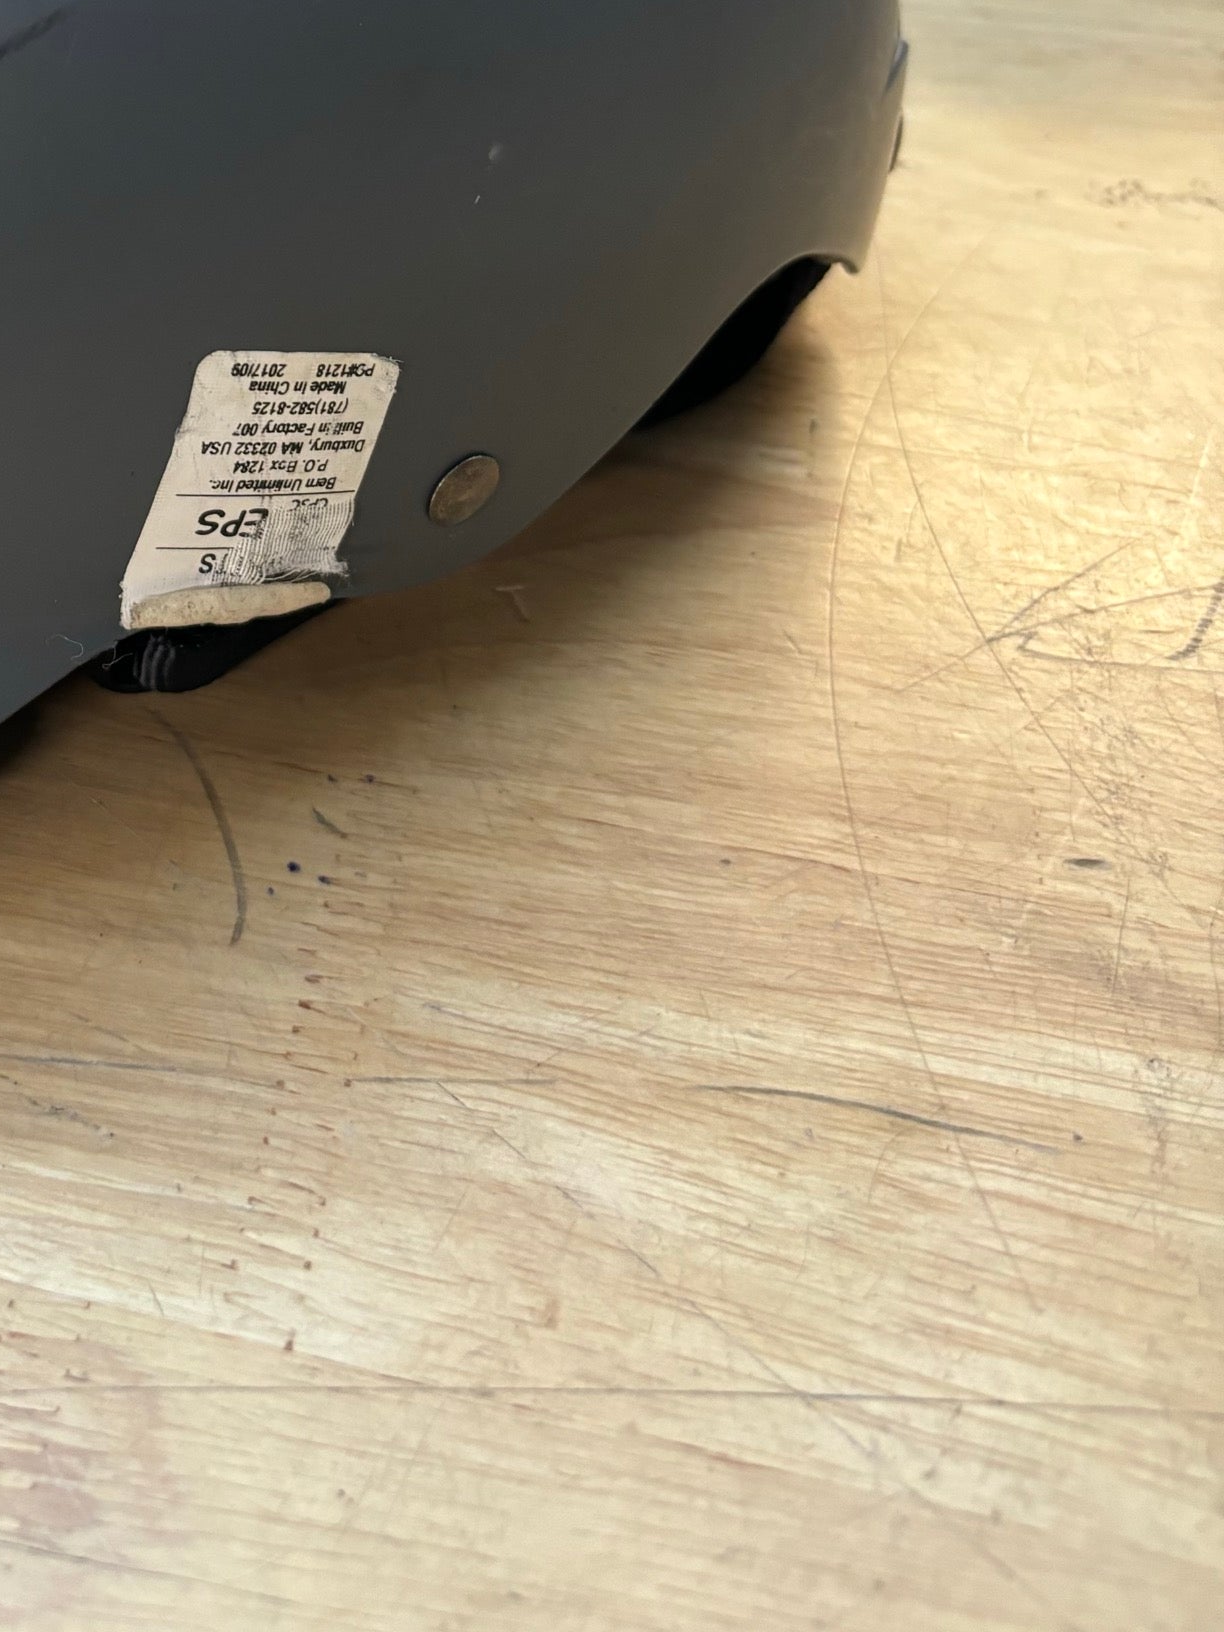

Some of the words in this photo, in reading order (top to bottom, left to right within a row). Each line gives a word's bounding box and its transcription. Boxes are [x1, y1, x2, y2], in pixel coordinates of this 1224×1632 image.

[231, 364, 287, 376] 2017/09
[249, 380, 290, 394] China
[310, 381, 346, 394] Made
[252, 400, 349, 415] (781)582-8125
[232, 422, 258, 436] 007
[263, 420, 314, 436] Factory
[201, 441, 231, 454] USA
[235, 441, 276, 454] 02332
[282, 440, 304, 454] MA
[308, 439, 365, 452] Duxbury,
[233, 460, 265, 474] 1284
[268, 460, 298, 472] Box
[304, 459, 328, 472] P.O.
[209, 479, 234, 490] Inc.
[236, 477, 302, 490] Unlimited
[306, 477, 336, 488] Bern
[194, 507, 270, 541] EPS
